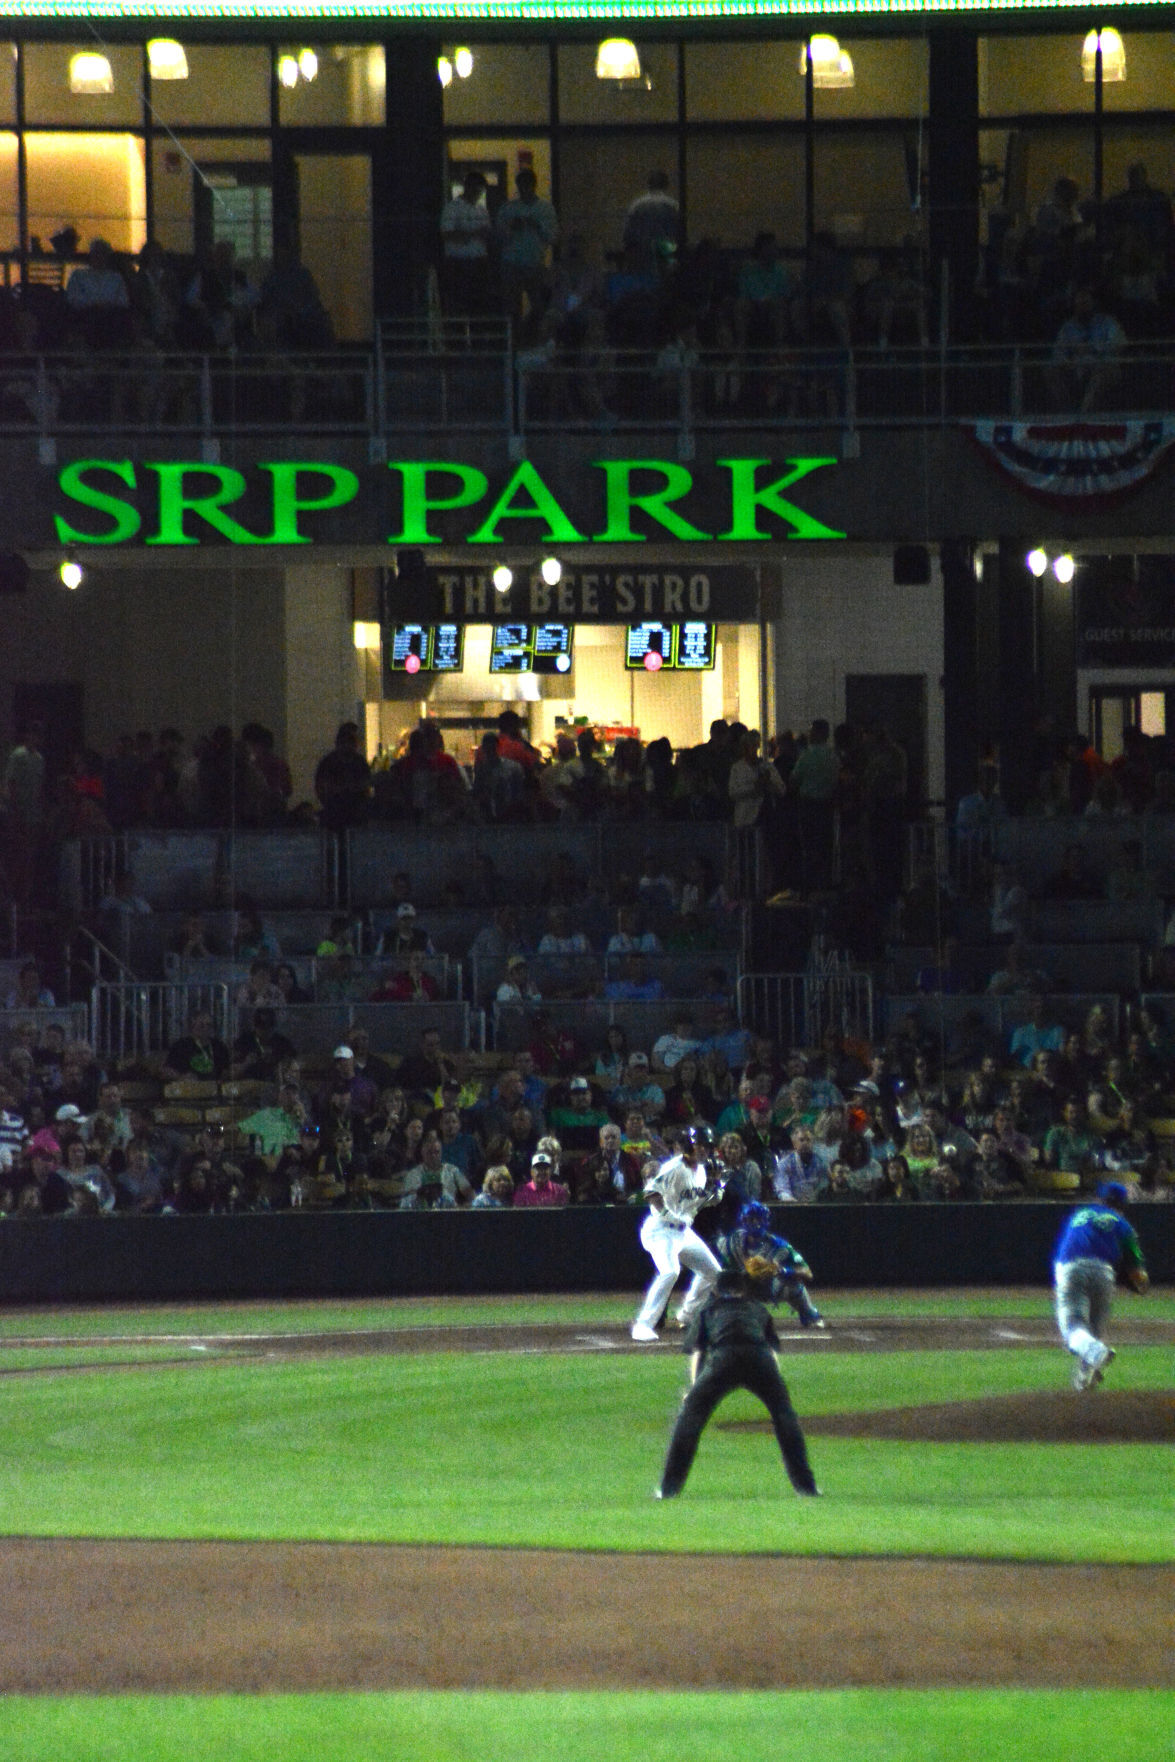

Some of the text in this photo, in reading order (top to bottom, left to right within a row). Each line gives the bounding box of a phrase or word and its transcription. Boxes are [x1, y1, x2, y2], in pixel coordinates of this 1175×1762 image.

[53, 457, 847, 545] SRP PARK
[530, 574, 711, 614] BEE'STRO
[1084, 627, 1125, 641] GUEST
